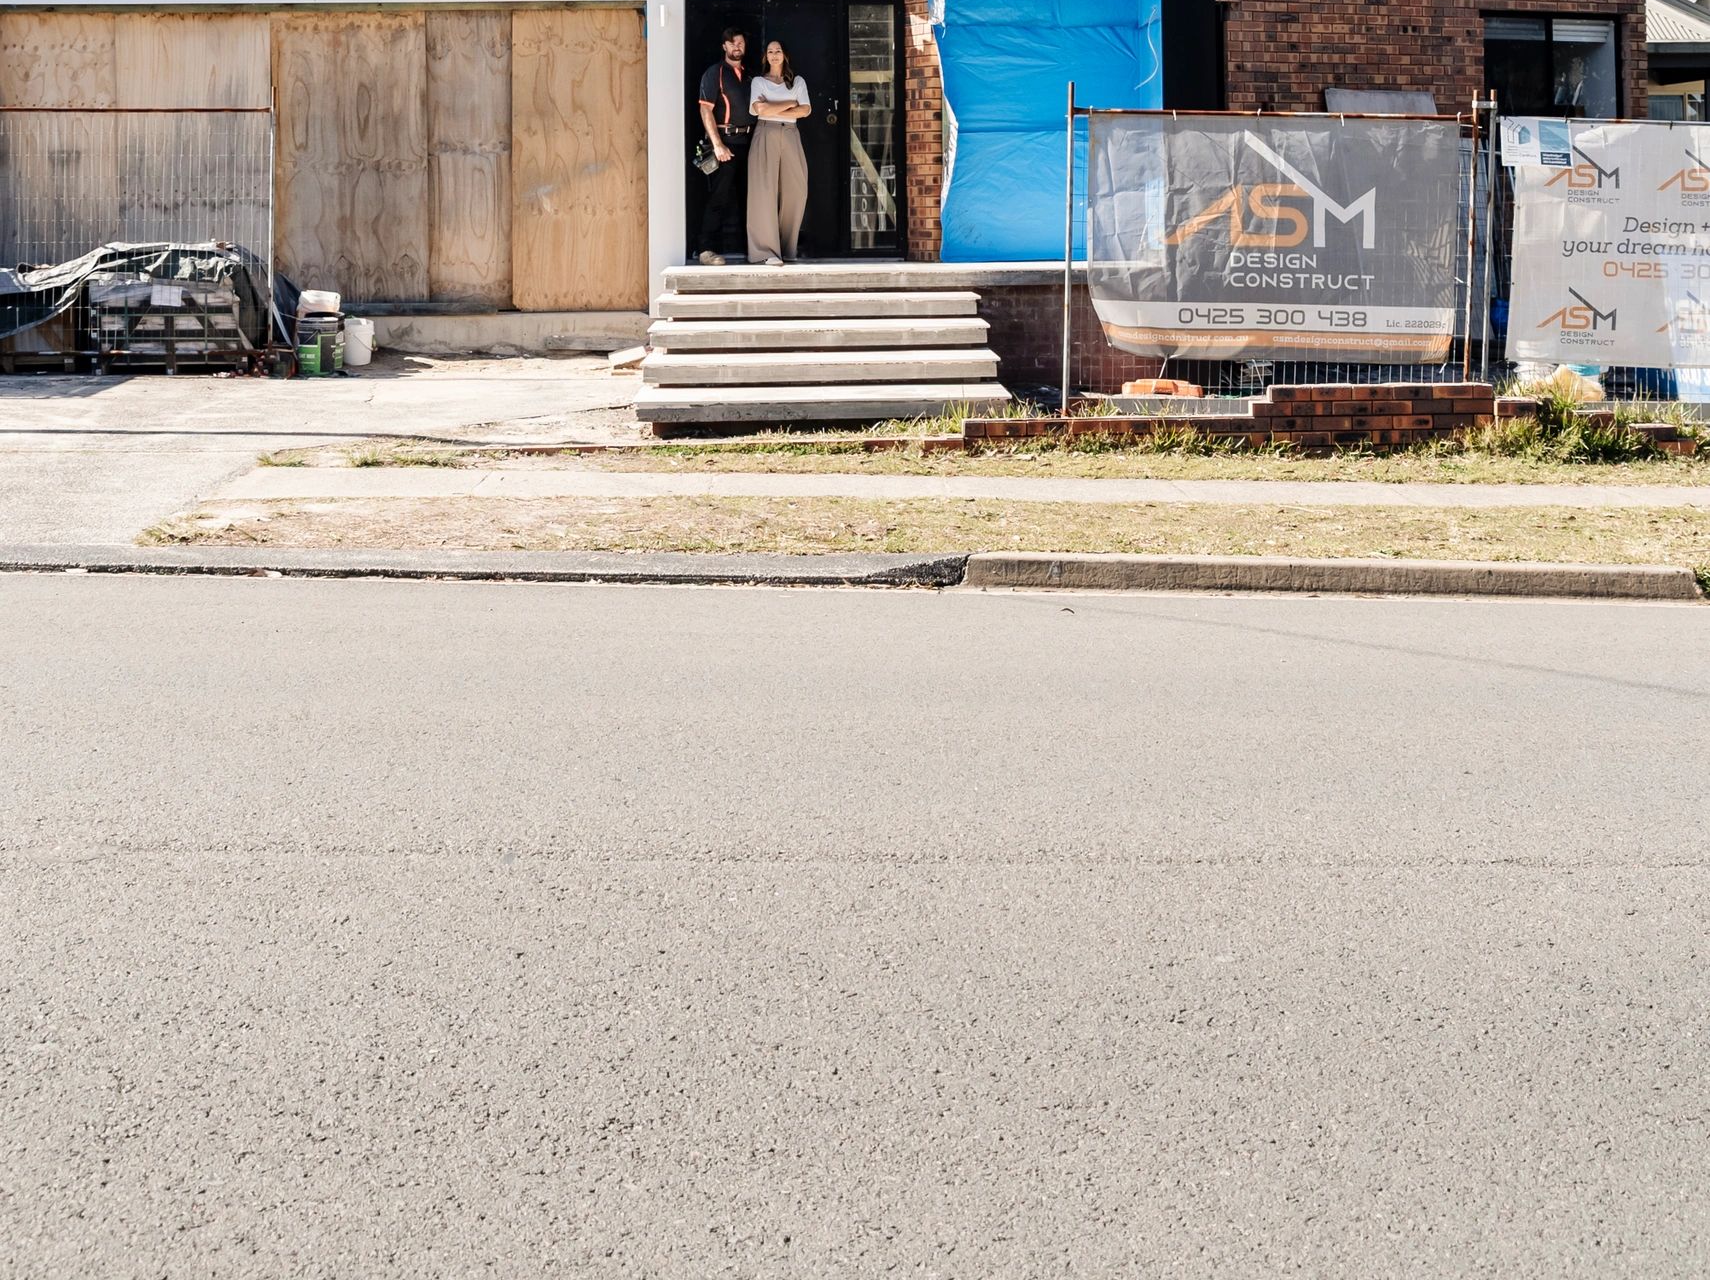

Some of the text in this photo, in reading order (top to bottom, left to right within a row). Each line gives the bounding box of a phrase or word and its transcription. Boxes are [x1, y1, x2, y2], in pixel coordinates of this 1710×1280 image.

[1544, 145, 1620, 189] ASM
[1161, 129, 1376, 249] ASM
[1567, 196, 1620, 204] CONSTRUCT
[1622, 216, 1696, 238] Design
[1562, 239, 1612, 257] your
[1617, 238, 1686, 256] dream
[1230, 252, 1317, 269] DESIGN
[1603, 261, 1669, 279] 0425
[1230, 272, 1376, 291] CONSTRUCT
[1178, 308, 1368, 327] 0425 300 438
[1536, 286, 1617, 331] ASM
[1560, 330, 1594, 338] DESIGN
[1560, 337, 1615, 346] CONSTRUCT
